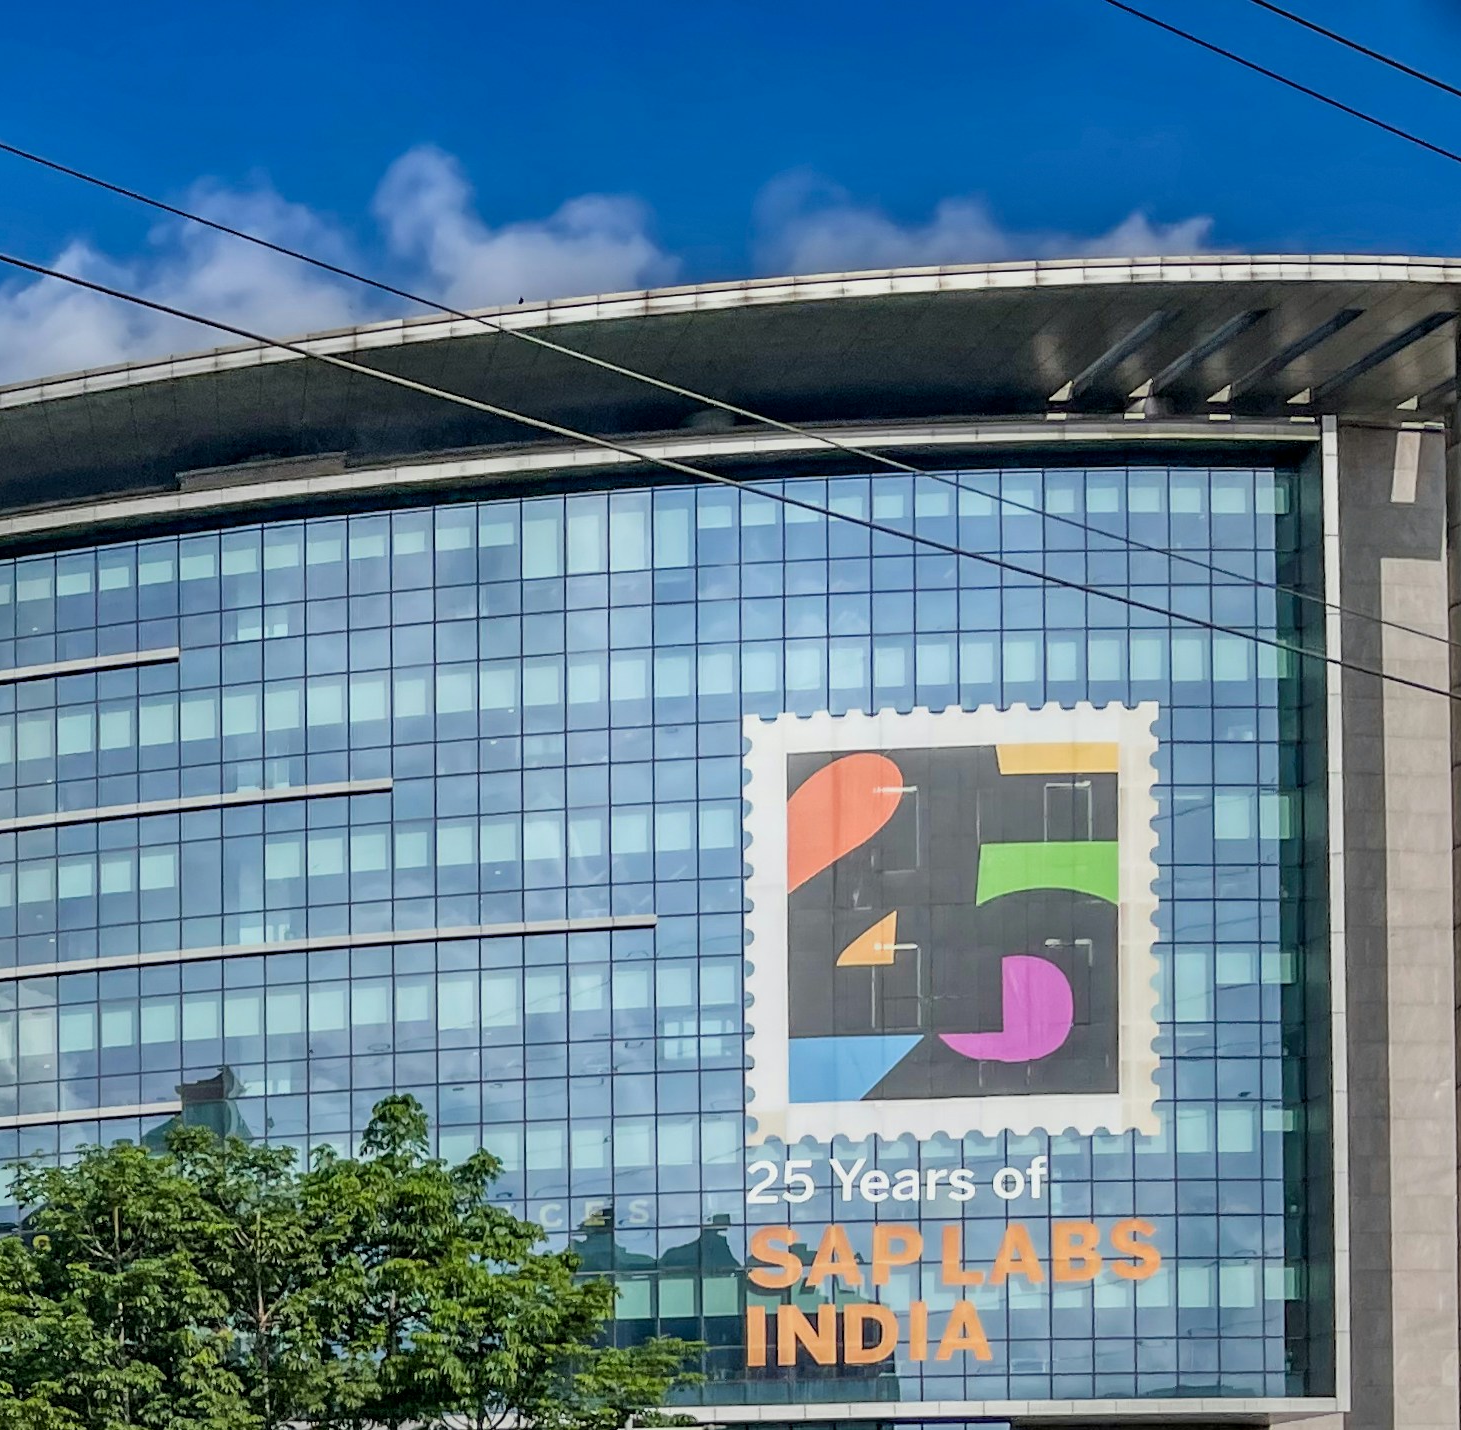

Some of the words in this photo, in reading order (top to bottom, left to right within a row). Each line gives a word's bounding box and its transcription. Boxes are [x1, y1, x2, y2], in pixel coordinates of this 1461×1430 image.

[746, 1160, 815, 1204] 25
[829, 1157, 977, 1202] Years
[992, 1155, 1050, 1200] of
[747, 1223, 924, 1289] SAP
[941, 1217, 1162, 1287] LABS
[746, 1299, 993, 1368] INDIA
